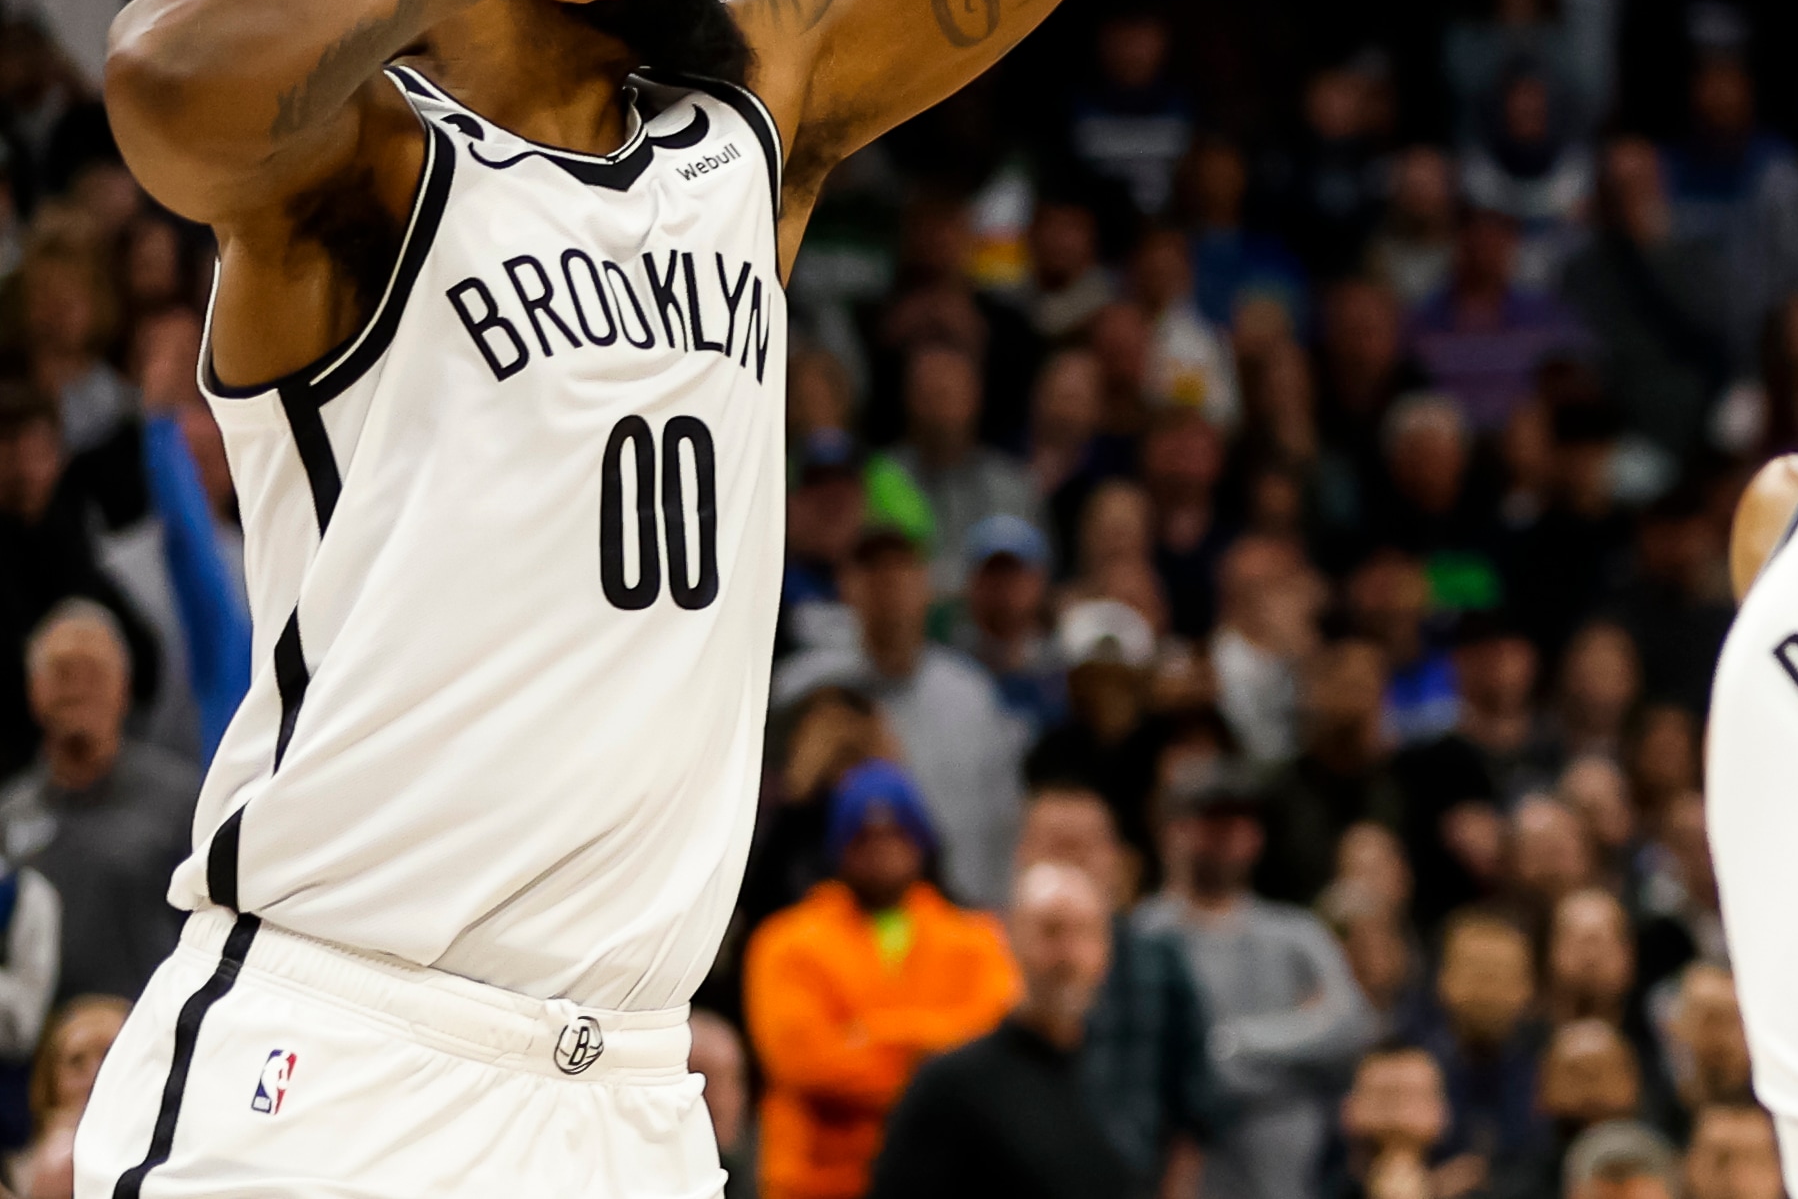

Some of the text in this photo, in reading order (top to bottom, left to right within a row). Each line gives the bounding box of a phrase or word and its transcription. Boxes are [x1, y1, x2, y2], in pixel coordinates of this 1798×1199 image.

[675, 143, 742, 181] Webull
[445, 248, 772, 385] BROOKLYN
[600, 415, 719, 610] 00
